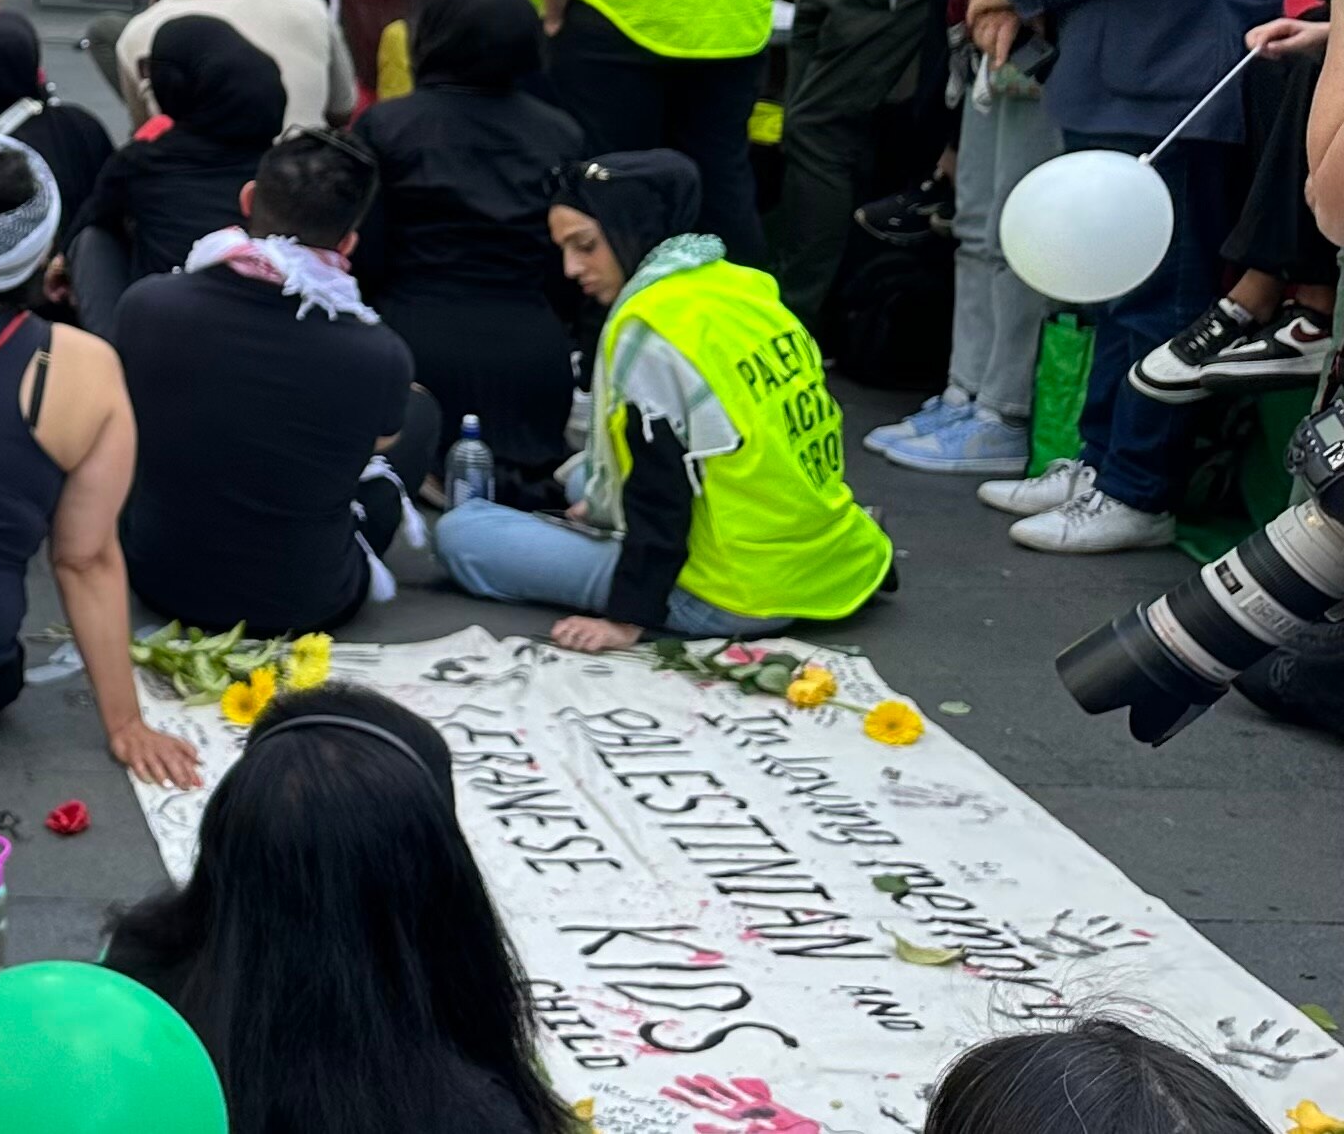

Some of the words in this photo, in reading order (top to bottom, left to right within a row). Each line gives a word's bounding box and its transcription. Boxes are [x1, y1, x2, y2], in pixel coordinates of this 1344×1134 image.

[430, 704, 623, 874] LEBANESE
[557, 922, 800, 1054] KIDS
[554, 706, 891, 959] PALESTINIAN
[832, 984, 925, 1031] AND
[750, 753, 904, 846] loving
